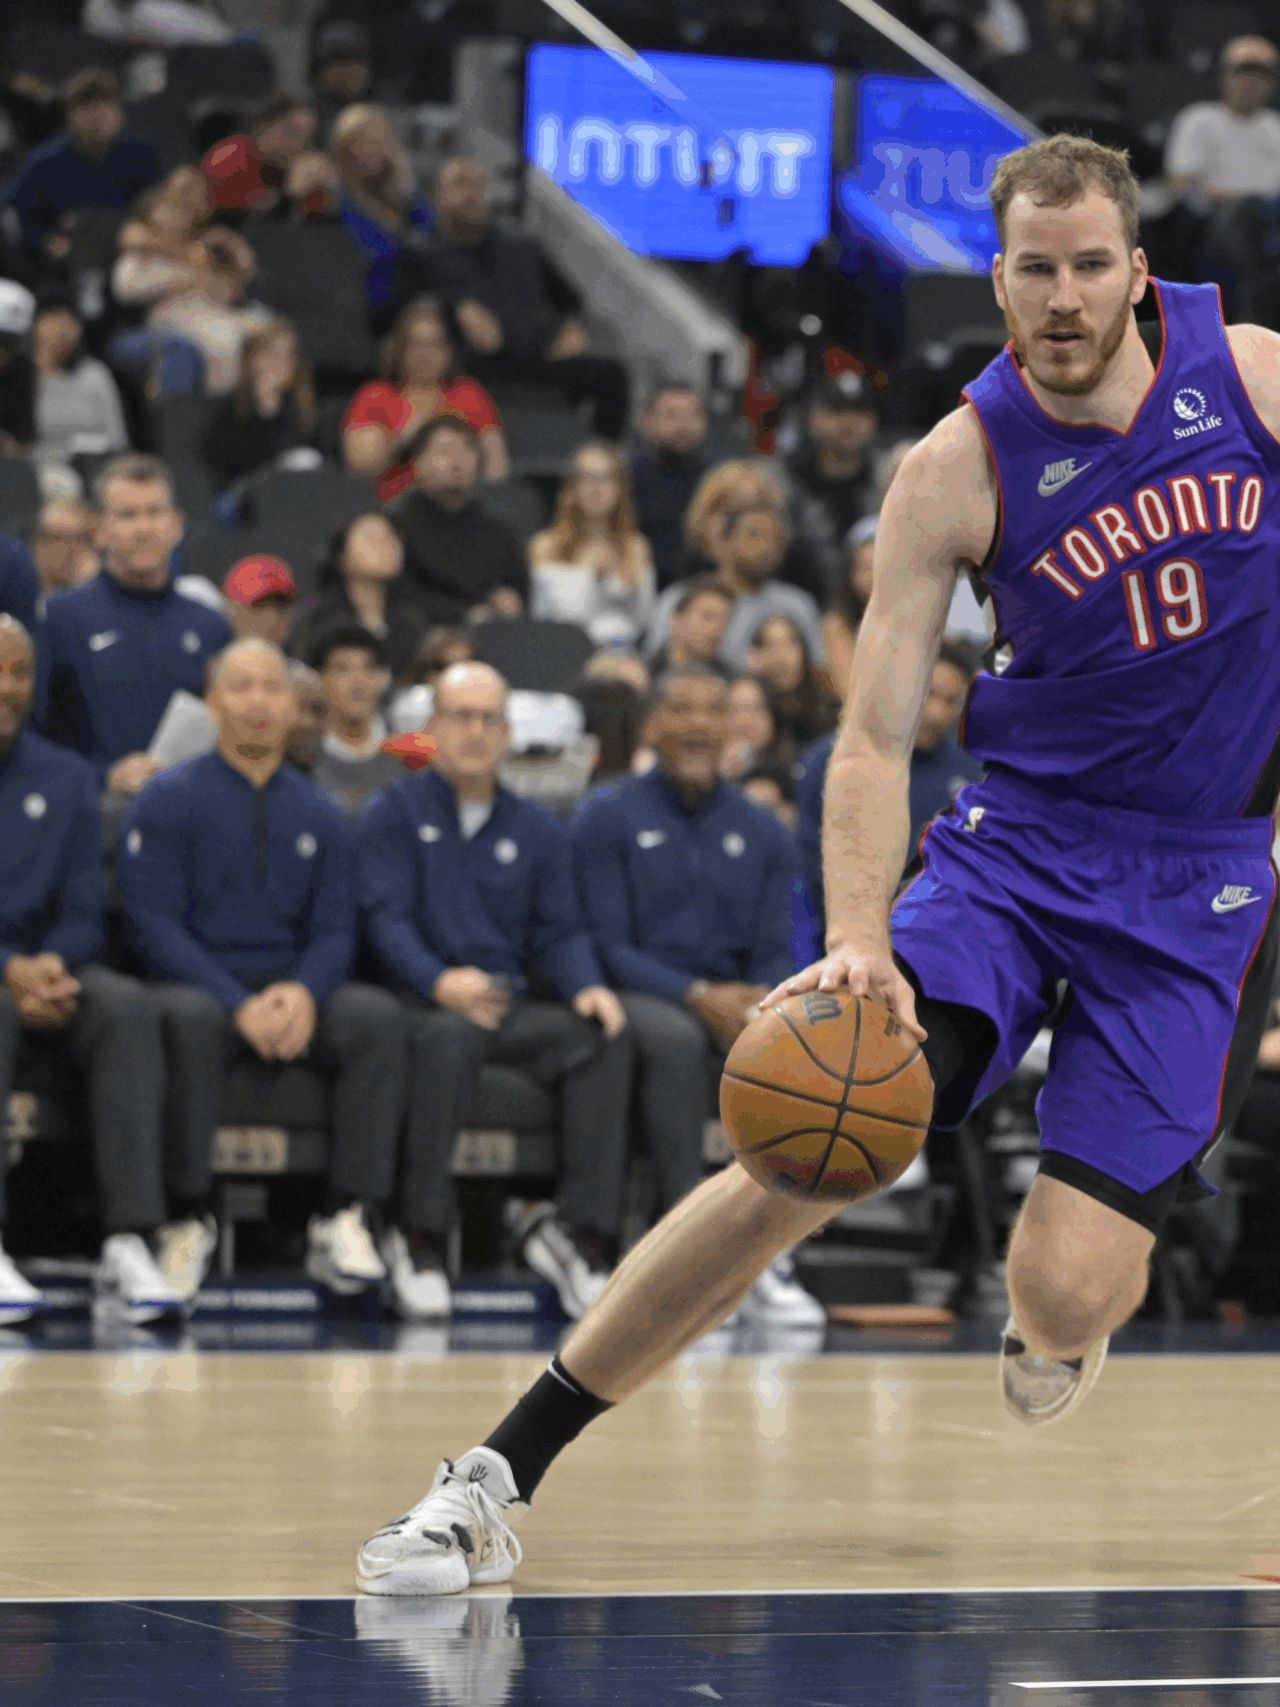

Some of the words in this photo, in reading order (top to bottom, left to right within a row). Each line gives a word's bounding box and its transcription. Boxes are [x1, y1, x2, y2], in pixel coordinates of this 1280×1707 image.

[1173, 427, 1199, 440] Sun
[1198, 415, 1223, 432] Life
[1044, 457, 1076, 483] NIKE
[1030, 472, 1264, 601] TORONTO
[1121, 557, 1208, 651] 19
[1220, 884, 1252, 903] NIKE
